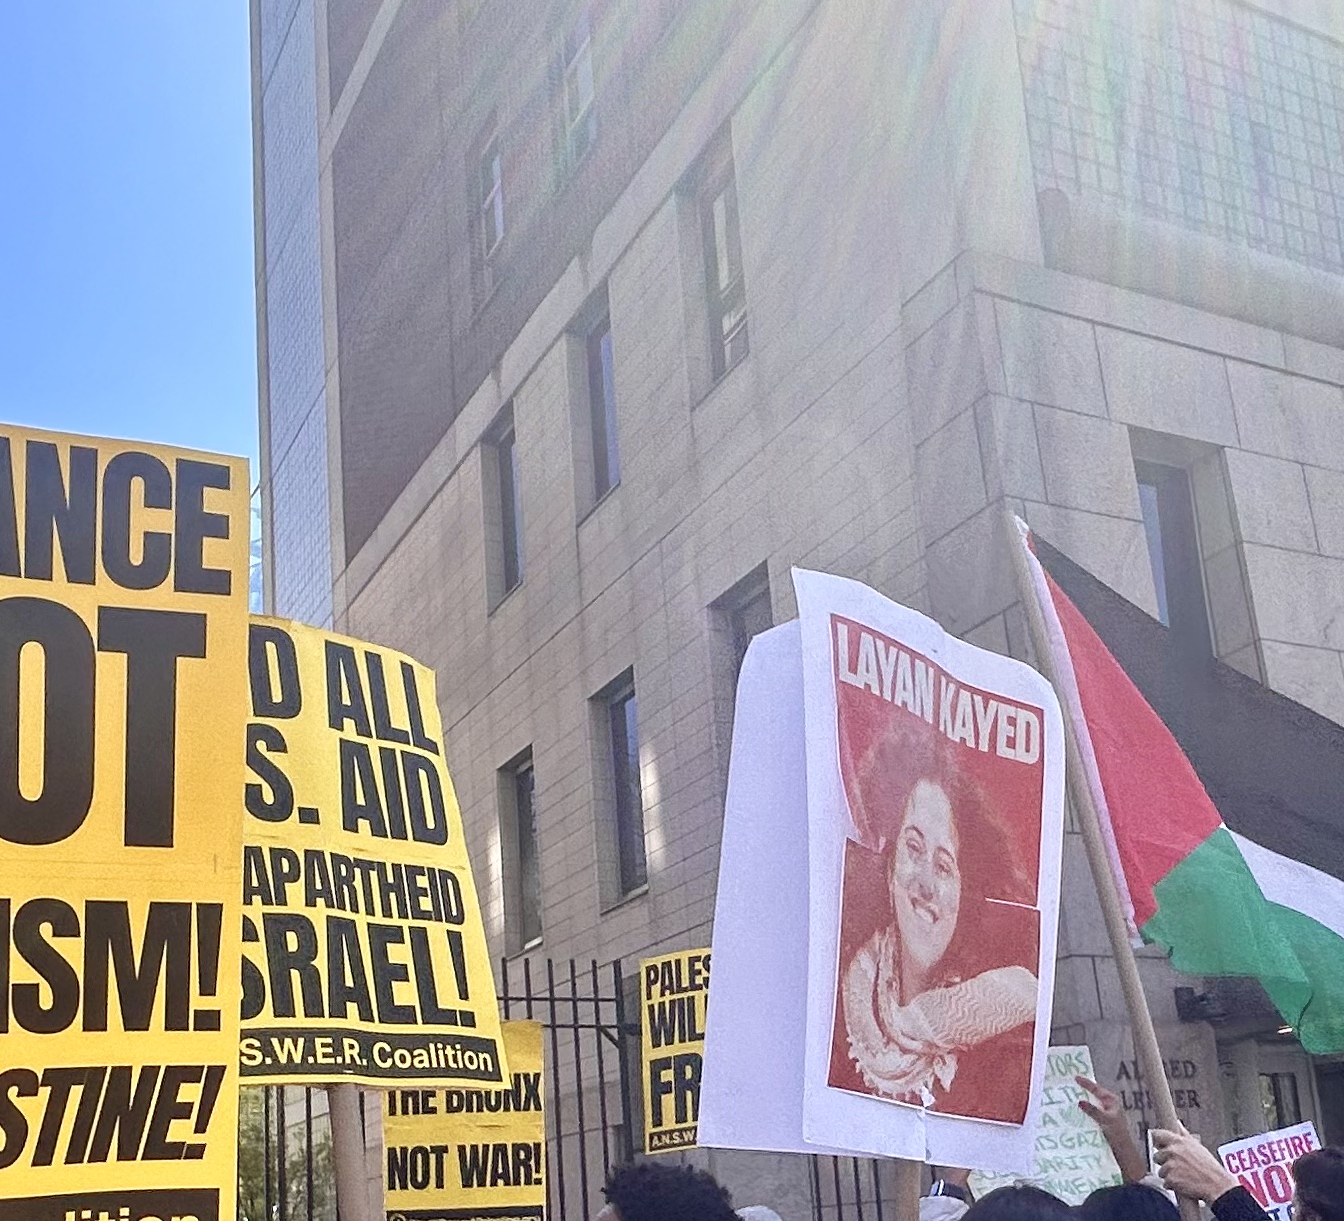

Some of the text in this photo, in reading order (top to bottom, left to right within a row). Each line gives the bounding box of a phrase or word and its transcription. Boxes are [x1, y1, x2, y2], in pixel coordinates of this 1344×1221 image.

[248, 623, 438, 754] D ALL
[837, 622, 1040, 765] LAYAN KAYED
[245, 723, 449, 846] S. AID
[243, 845, 465, 925] APARTHEID
[240, 1037, 493, 1072] S.W.E.R. Coalition
[649, 1053, 703, 1128] FR
[387, 1142, 543, 1190] NOT WAR!
[1225, 1131, 1314, 1175] CEASEFIRE
[1237, 1160, 1294, 1208] NO
